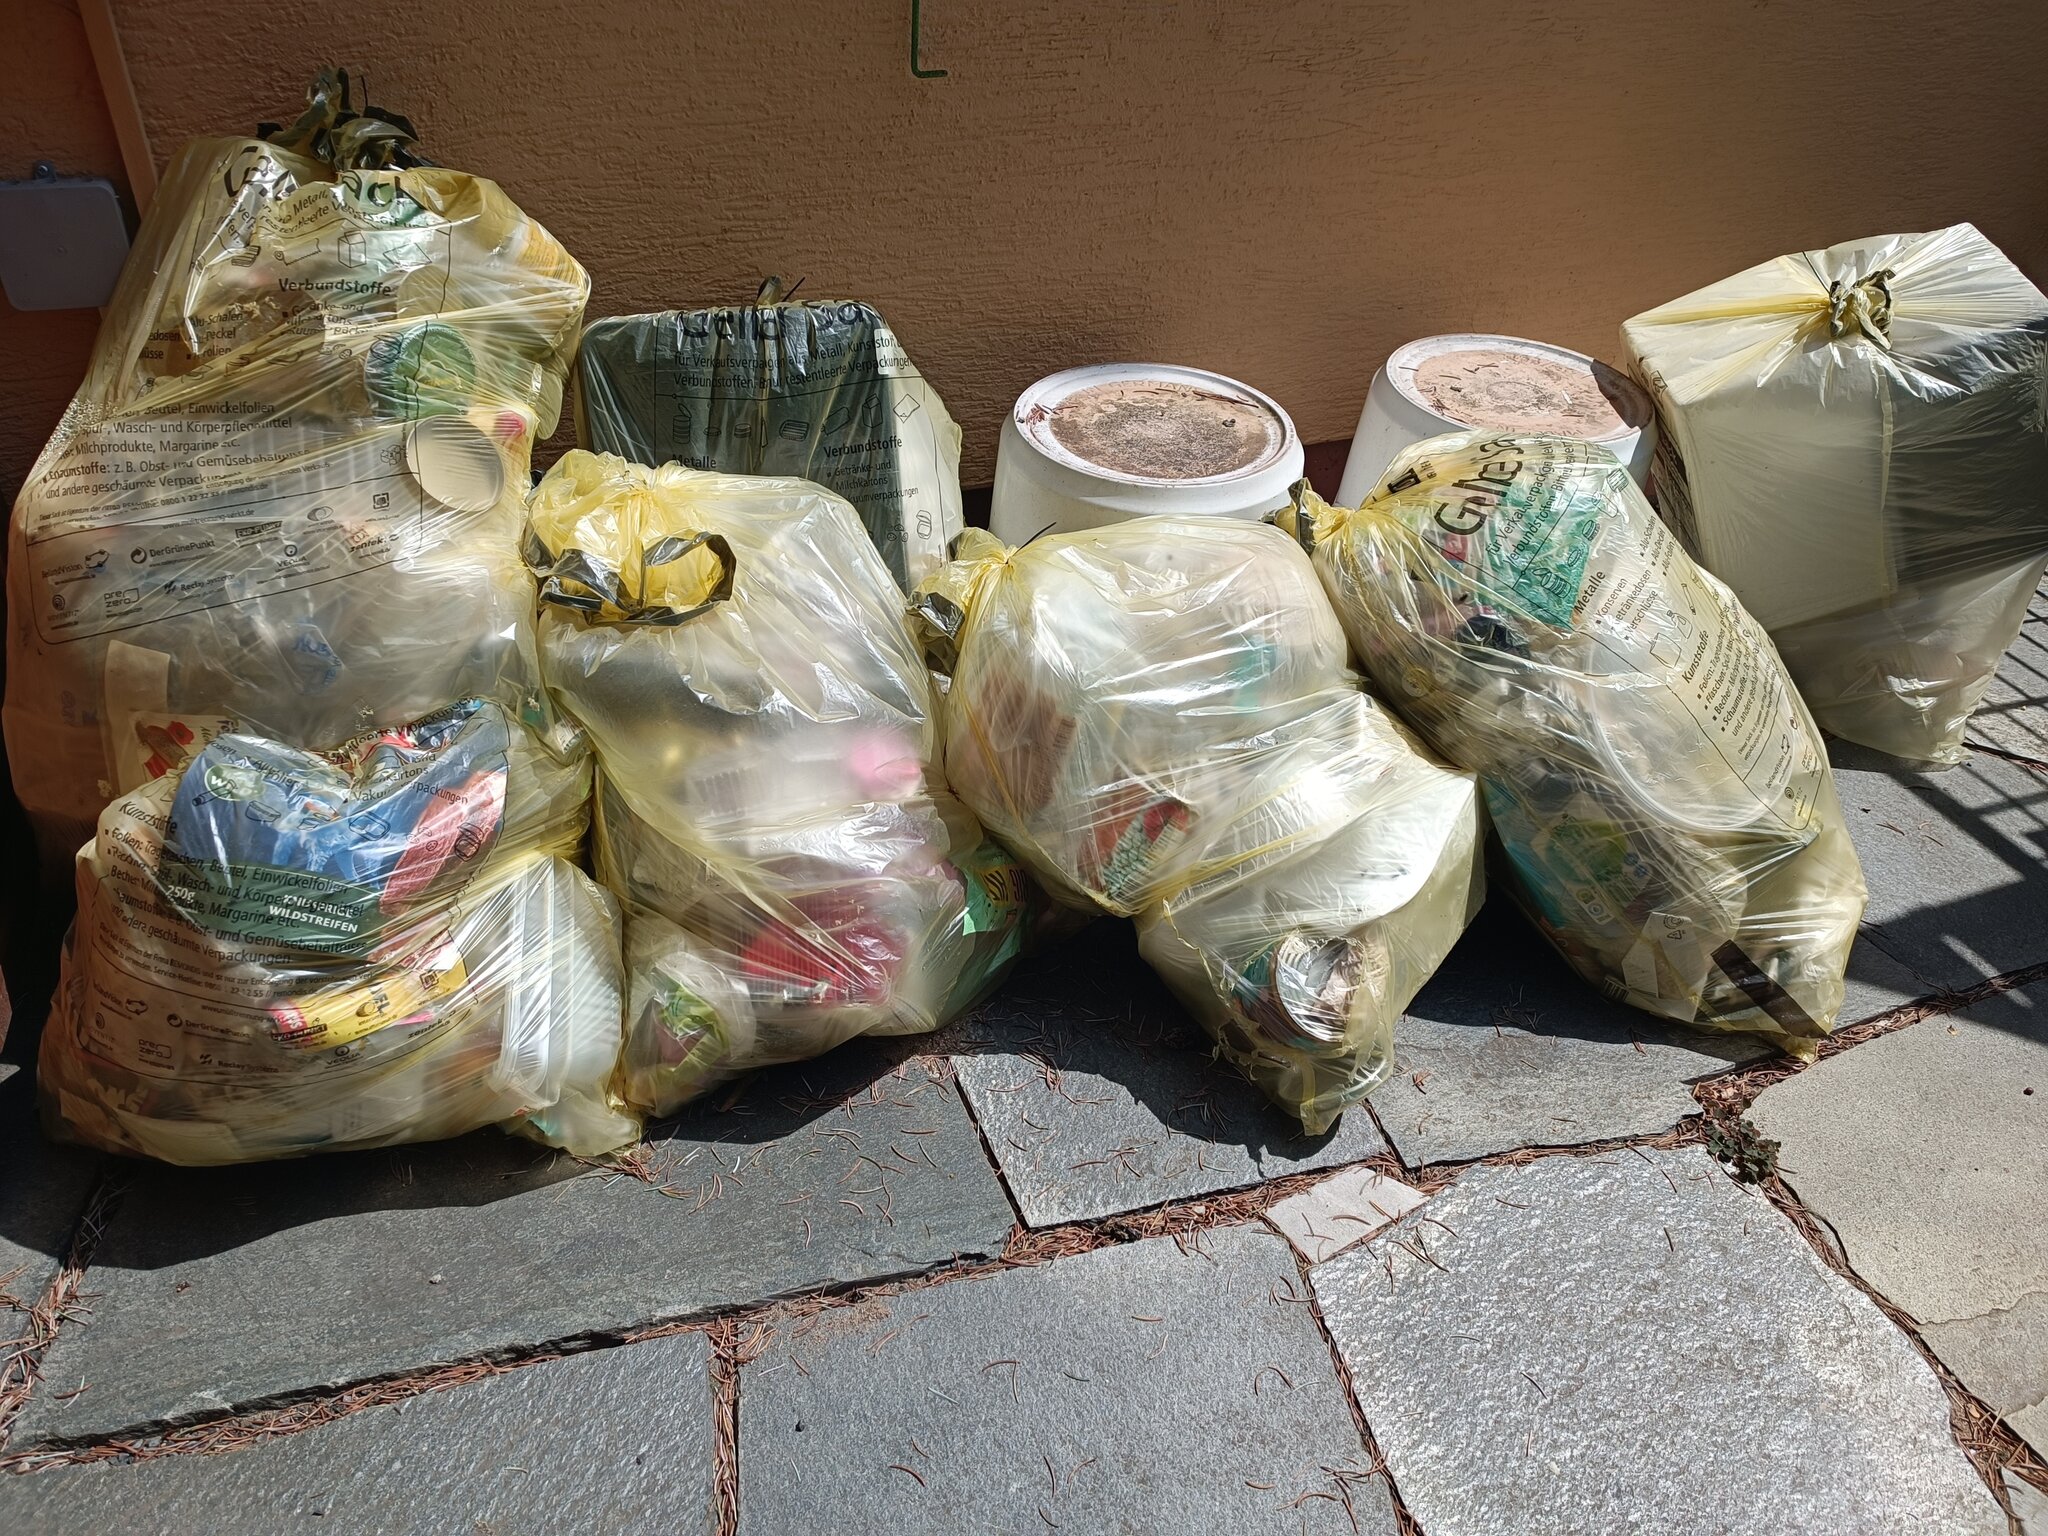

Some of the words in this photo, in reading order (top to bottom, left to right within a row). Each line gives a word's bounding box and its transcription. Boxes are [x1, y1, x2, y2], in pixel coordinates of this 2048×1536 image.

[278, 278, 393, 297] Verbundstoffe
[674, 351, 690, 367] für
[188, 401, 275, 415] Einwickelfolien
[113, 421, 156, 434] Wasch-
[160, 421, 183, 433] und
[75, 440, 154, 457] Milchprodukte,
[159, 439, 219, 455] Margarine
[823, 435, 904, 458] Verbundstoffe
[139, 460, 171, 473] Obst-
[671, 453, 718, 469] Metalle
[834, 462, 874, 478] Getränke-
[876, 459, 893, 471] und
[61, 483, 91, 498] andere
[836, 476, 889, 491] Milchkartons
[1575, 570, 1606, 615] Metalle
[1596, 577, 1629, 618] Konserven
[1624, 589, 1658, 634] Verschlüsse
[1681, 629, 1710, 685] Kunststoffe
[111, 826, 144, 850] Folien:
[252, 867, 350, 894] Einwickelfolien
[178, 872, 216, 890] Wasch-
[217, 883, 241, 898] und
[209, 901, 274, 925] Margarine
[277, 914, 301, 929] etc.
[269, 905, 359, 934] WILDSTREIFEN
[215, 927, 241, 942] und
[148, 925, 200, 953] geschäumte
[202, 943, 292, 965] Verpackungen
